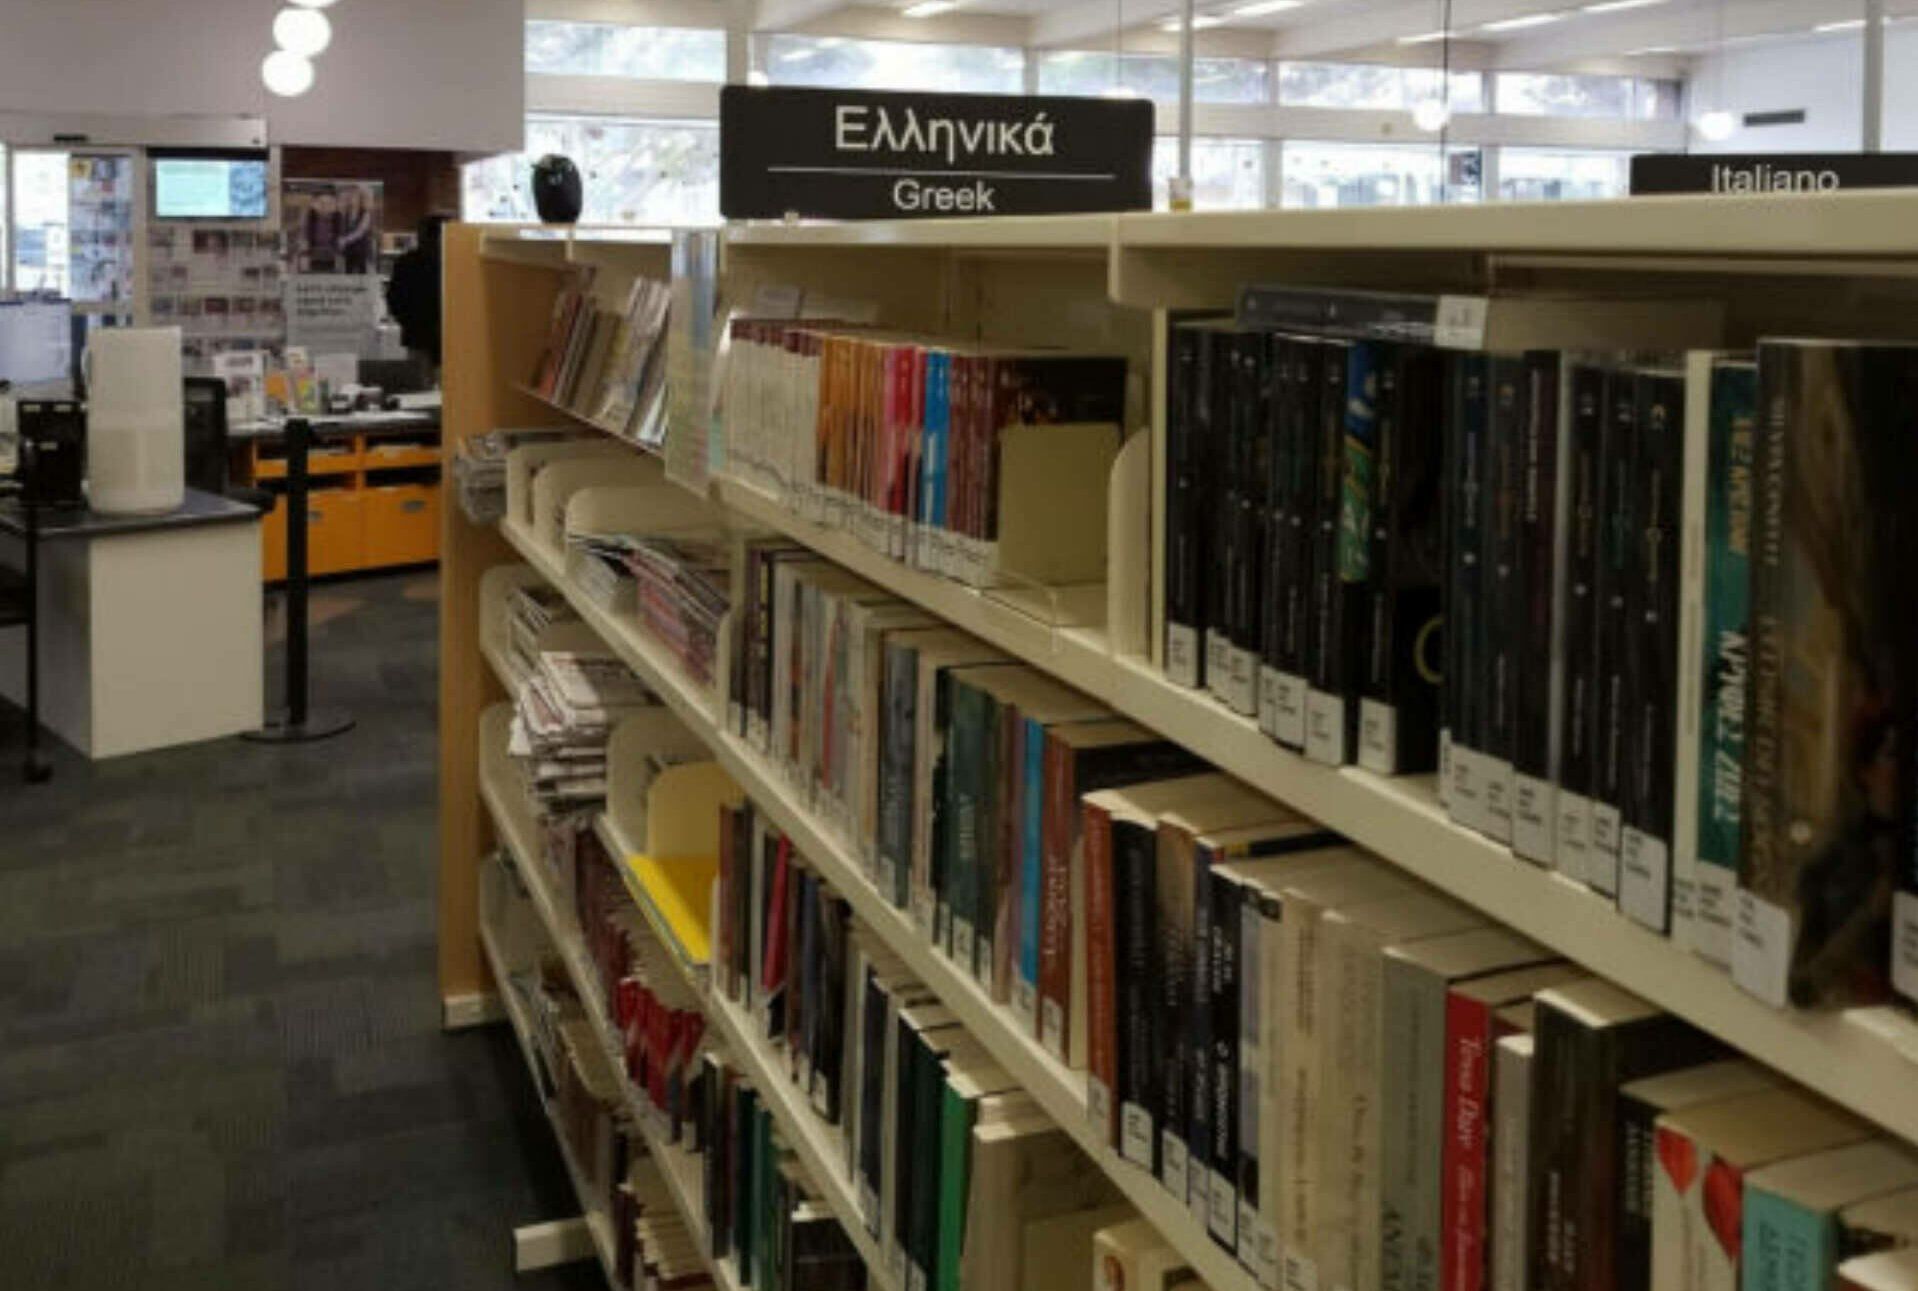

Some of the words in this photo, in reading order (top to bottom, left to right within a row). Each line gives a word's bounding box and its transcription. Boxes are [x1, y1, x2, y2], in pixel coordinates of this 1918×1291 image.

[834, 105, 1055, 164] Ελληνικά
[1712, 163, 1840, 193] Italiano
[892, 179, 995, 211] Greek
